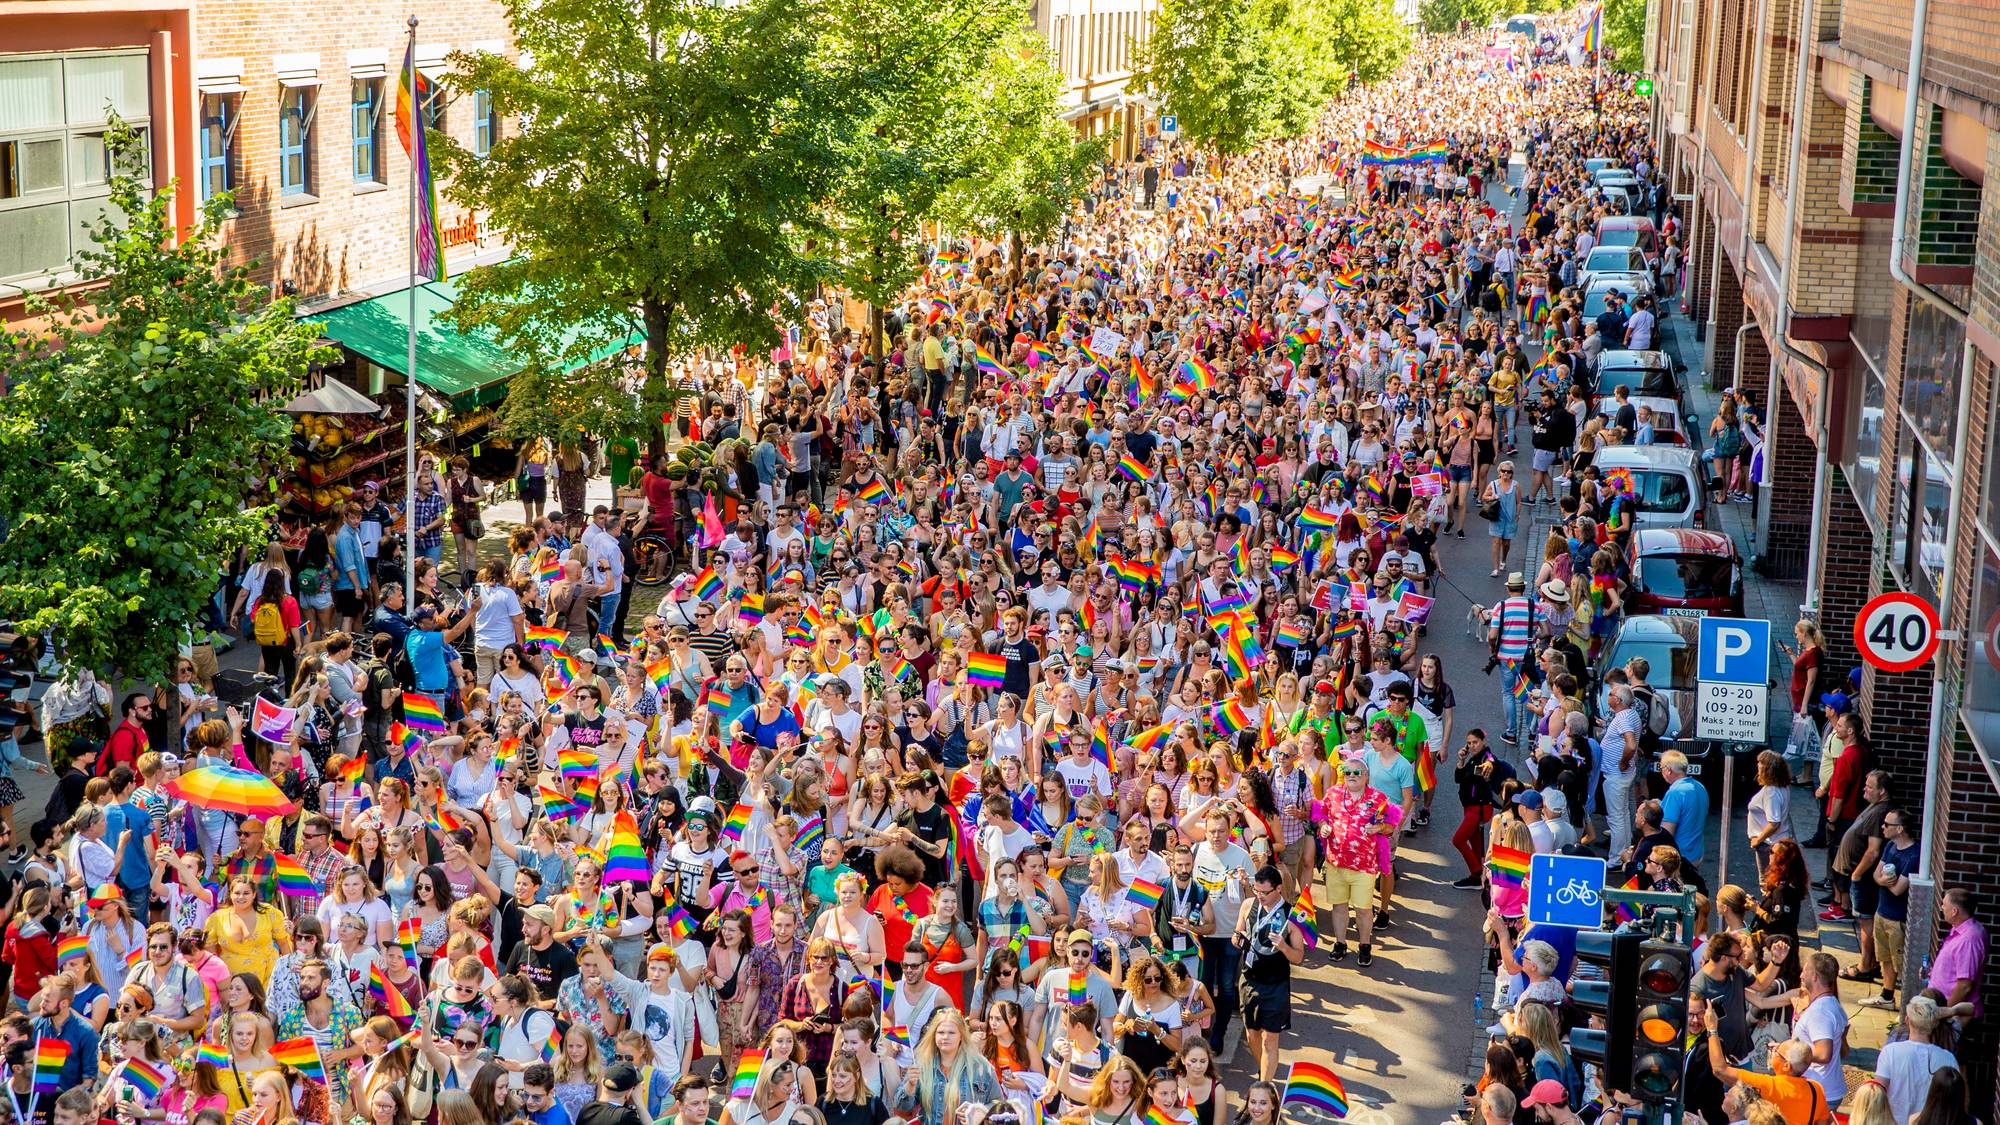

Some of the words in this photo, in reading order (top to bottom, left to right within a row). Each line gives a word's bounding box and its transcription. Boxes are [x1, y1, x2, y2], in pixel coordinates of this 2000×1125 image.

[1164, 118, 1173, 130] P
[1869, 614, 1926, 652] 40
[1716, 627, 1752, 674] P
[1712, 686, 1752, 700] 09-20
[1706, 702, 1758, 717] (09-20)
[1701, 716, 1724, 726] Maks
[1728, 718, 1734, 726] 2
[1738, 718, 1760, 727] timer
[1708, 728, 1724, 736] mot
[1728, 728, 1754, 739] avgift
[680, 862, 704, 874] BRKLY
